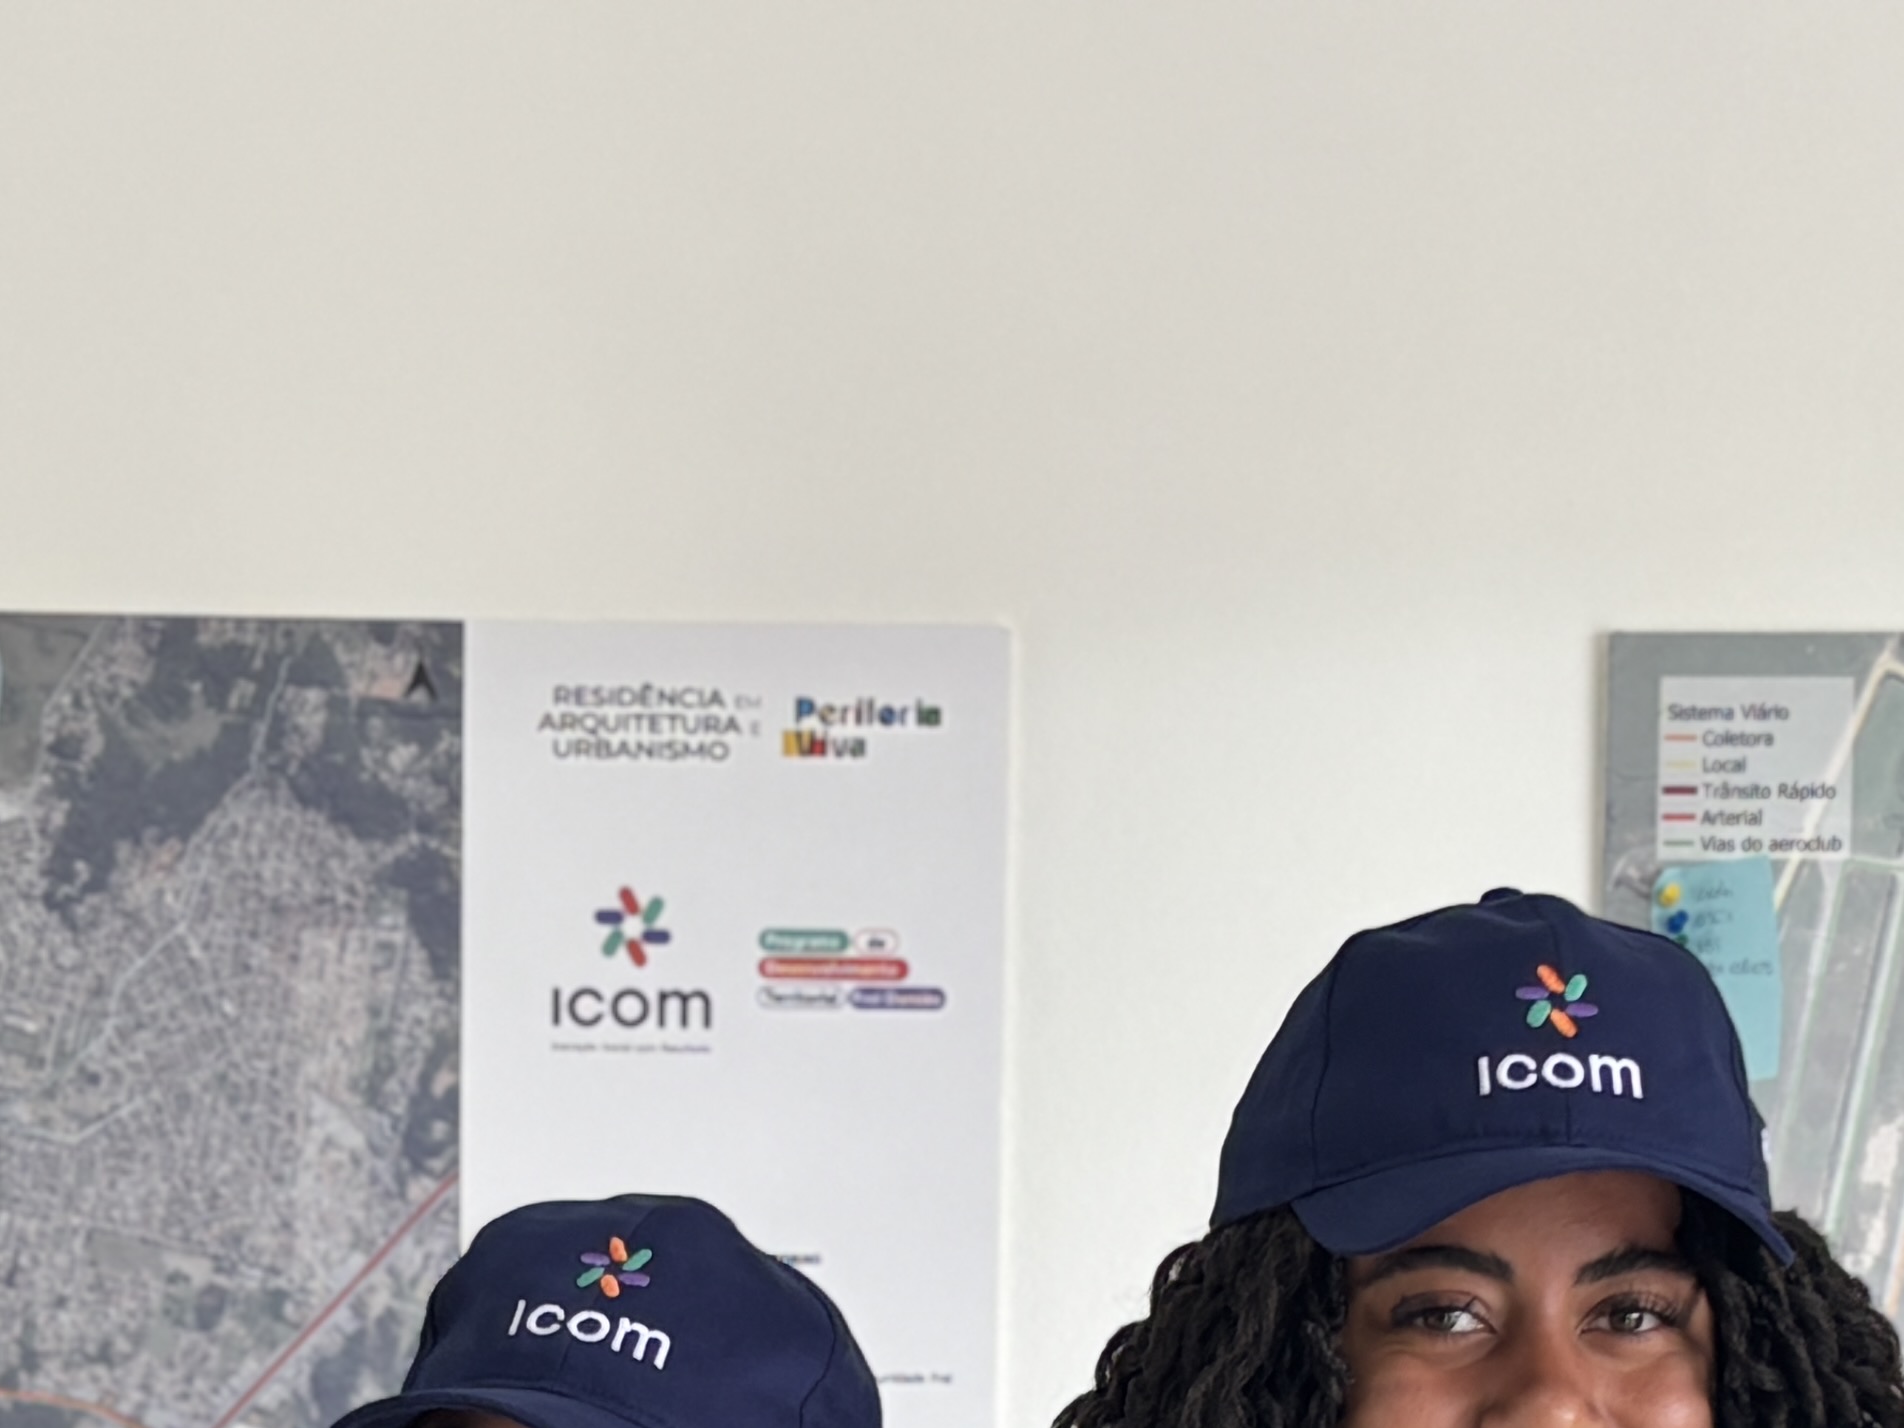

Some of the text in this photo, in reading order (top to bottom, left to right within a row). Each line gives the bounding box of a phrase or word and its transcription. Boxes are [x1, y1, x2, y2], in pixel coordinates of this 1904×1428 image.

[553, 681, 726, 708] RESIDÊNCIA
[1668, 702, 1790, 721] Sistema Viário
[537, 712, 741, 735] ARQUITETURA
[1702, 730, 1774, 747] Coletora
[553, 738, 730, 761] URBANISMO
[1702, 757, 1746, 773] Local
[1702, 781, 1836, 802] Trânsito Rápido
[1701, 809, 1763, 826] Arterial
[1700, 836, 1842, 851] Vias do aeroclub
